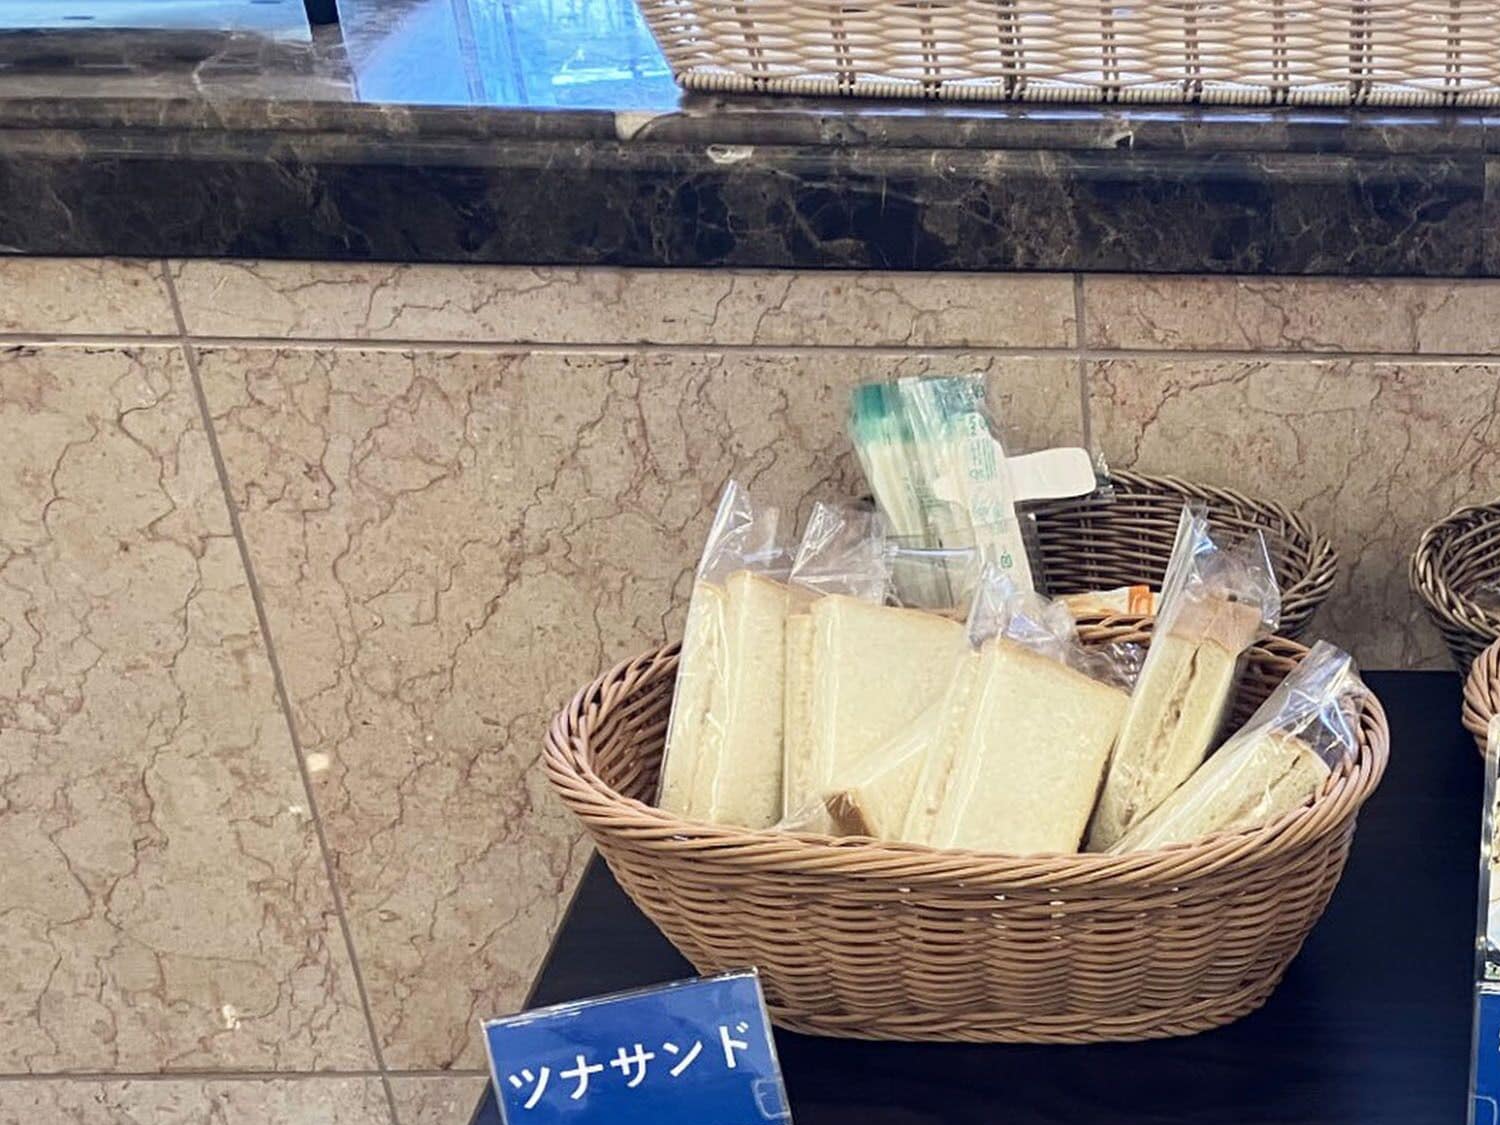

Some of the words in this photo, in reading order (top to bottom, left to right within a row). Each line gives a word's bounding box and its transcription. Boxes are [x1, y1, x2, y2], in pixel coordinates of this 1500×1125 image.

[509, 1021, 749, 1109] ツナサンド
